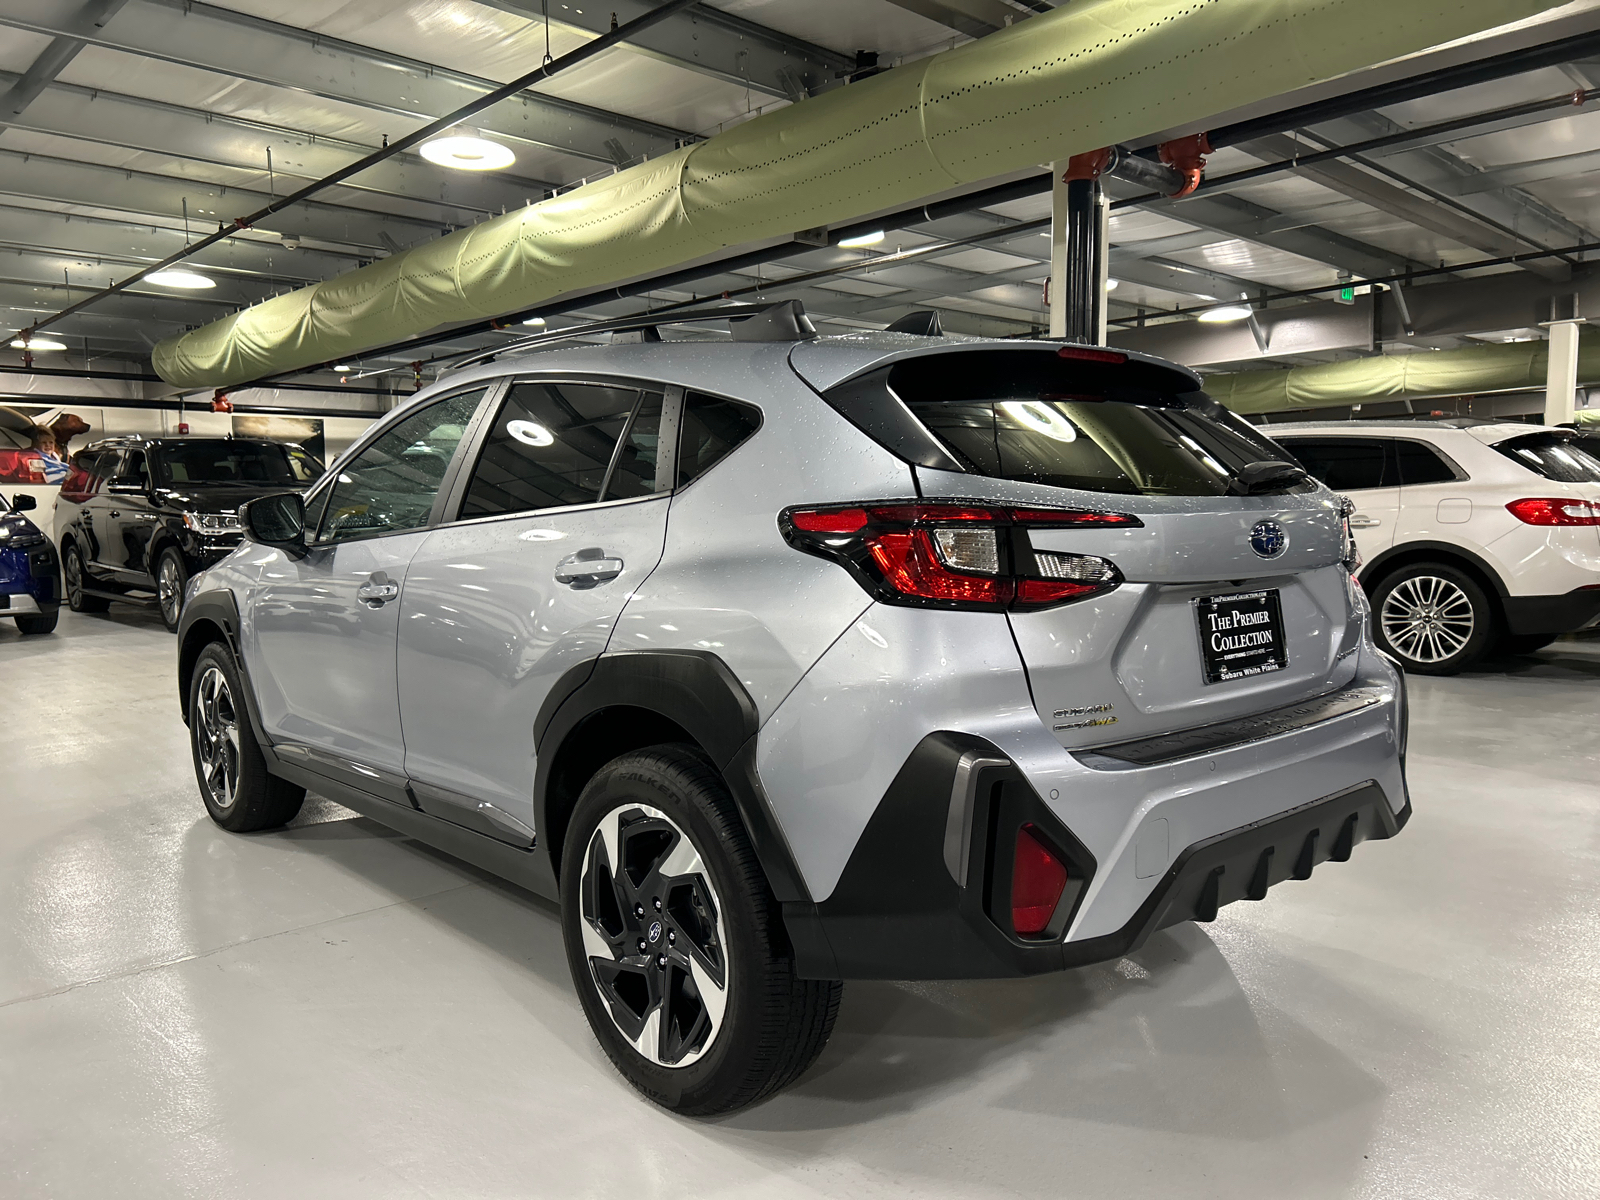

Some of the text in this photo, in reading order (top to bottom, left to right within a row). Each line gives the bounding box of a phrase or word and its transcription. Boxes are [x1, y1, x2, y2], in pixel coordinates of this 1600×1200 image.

[1208, 610, 1270, 631] THE PREMIER
[1211, 629, 1273, 652] COLLECTION
[1221, 663, 1279, 680] Subaru White Plains
[1053, 703, 1115, 718] SUBARU
[620, 772, 682, 805] FALKEN
